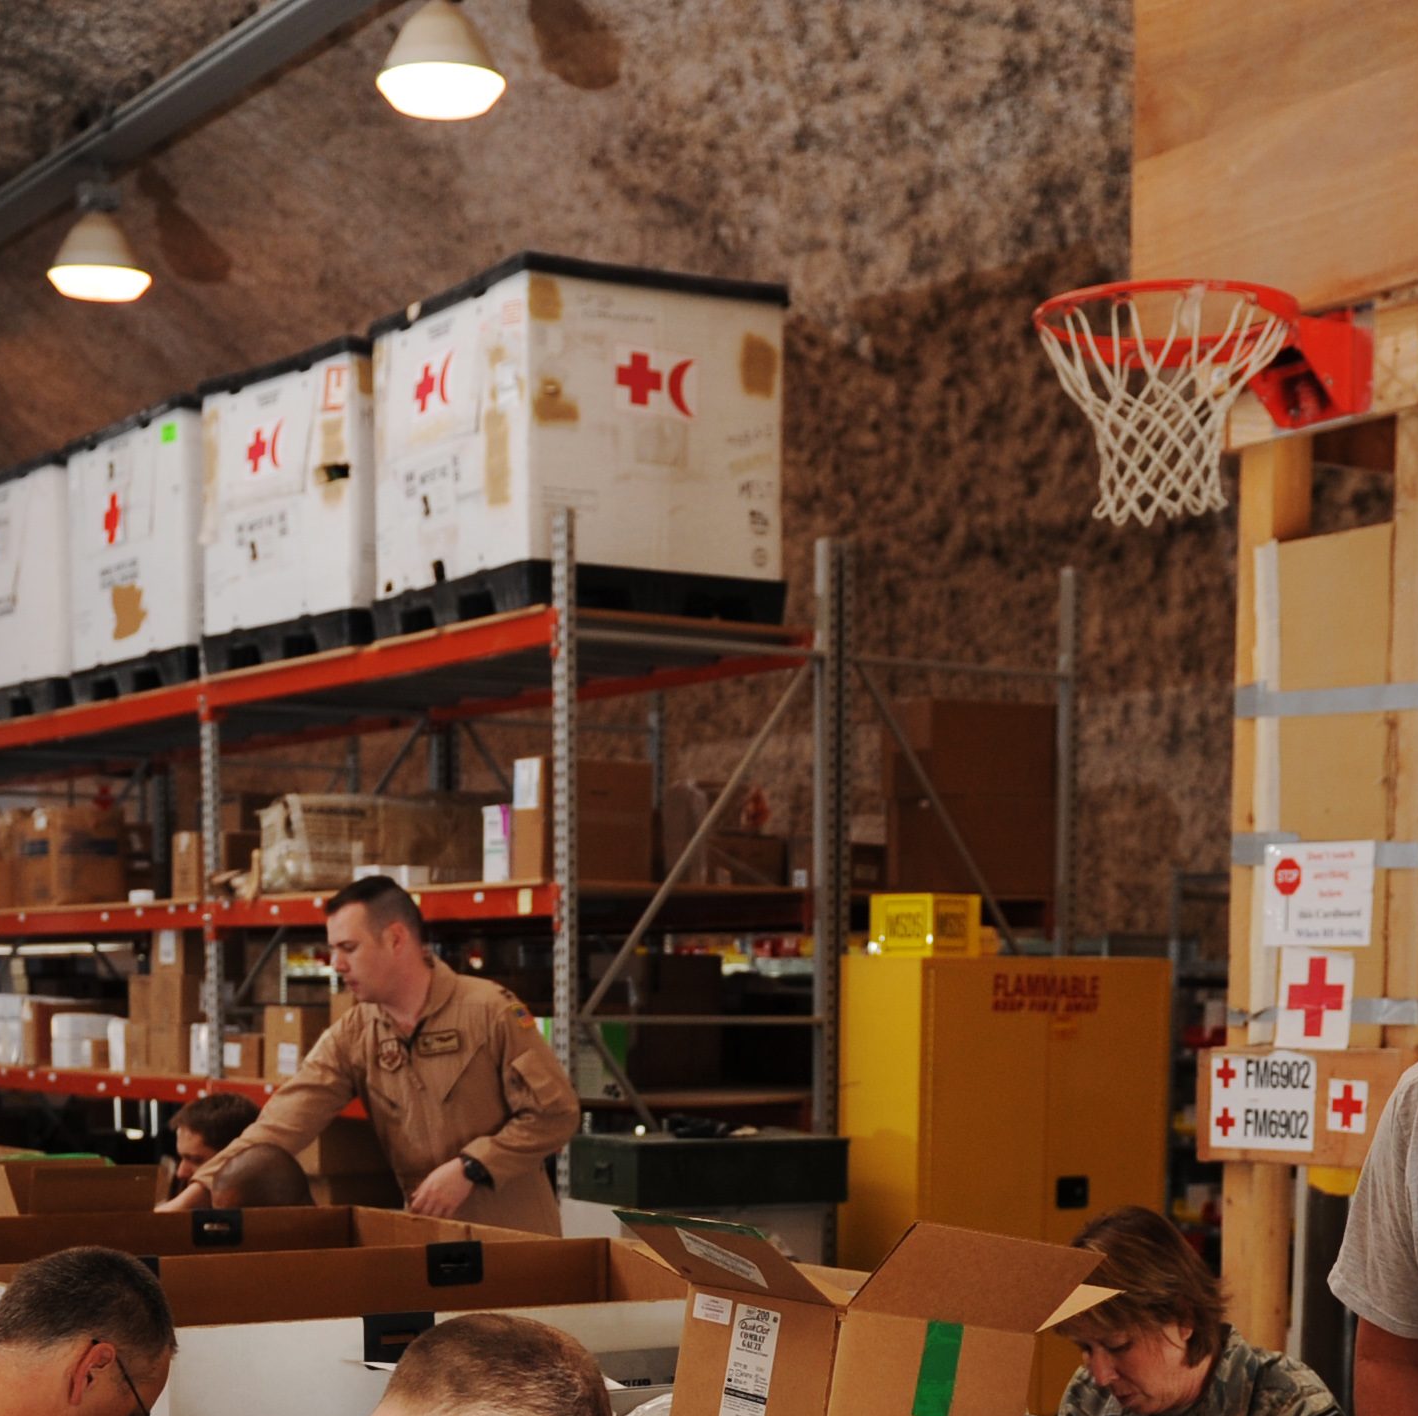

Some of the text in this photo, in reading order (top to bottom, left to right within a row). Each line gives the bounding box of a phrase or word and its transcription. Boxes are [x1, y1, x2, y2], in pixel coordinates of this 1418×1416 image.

[1277, 869, 1300, 884] STOP
[992, 972, 1101, 999] FLAMMABLE
[1245, 1058, 1312, 1090] FM6902
[1243, 1107, 1310, 1140] FM6902
[755, 1309, 771, 1322] 200
